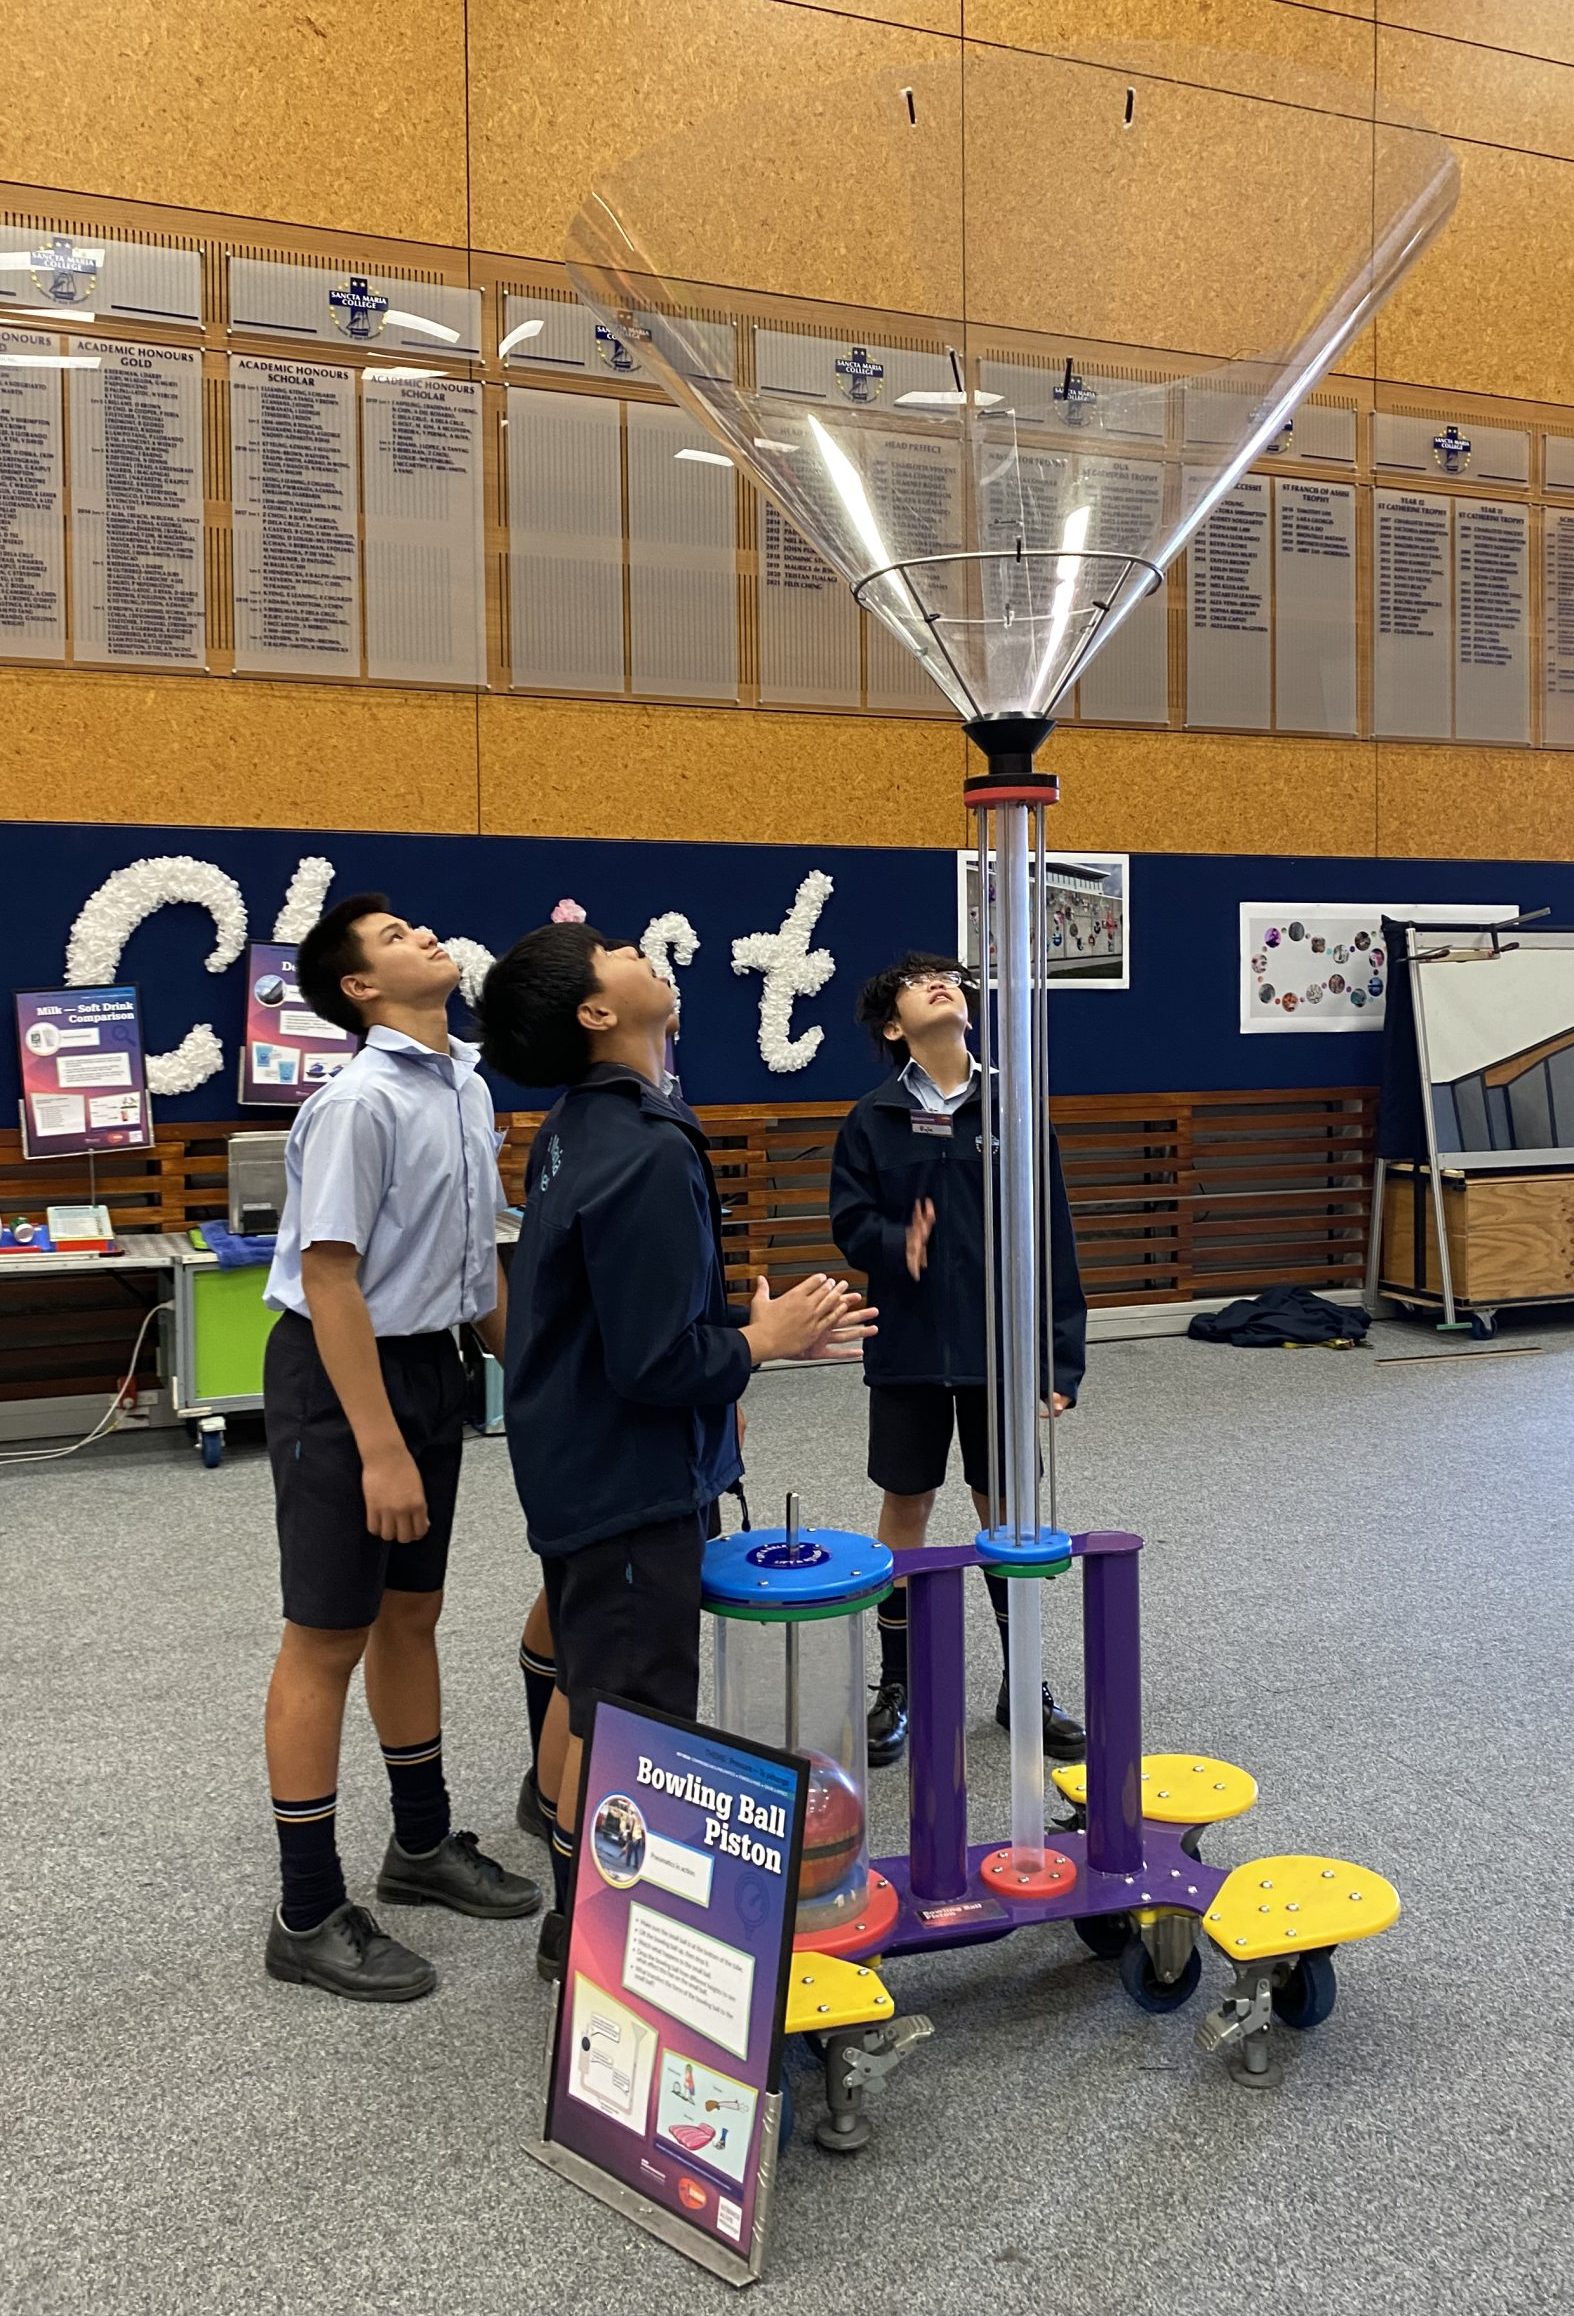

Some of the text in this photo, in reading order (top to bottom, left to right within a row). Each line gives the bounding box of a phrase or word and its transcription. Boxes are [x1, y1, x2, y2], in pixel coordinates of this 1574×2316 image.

[32, 252, 94, 266] SANCTA MARIA
[44, 261, 82, 270] COLLEGE
[331, 292, 387, 304] SANCTA MARIA
[342, 300, 376, 309] COLLEGE
[78, 342, 194, 361] ACADEMIC HONOURS
[121, 358, 152, 368] GOLD
[862, 363, 882, 371] MARIA
[239, 361, 348, 380] ACADEMIC HONOURS
[846, 367, 873, 375] COLLEGE
[268, 374, 314, 386] SCHOLAR
[371, 376, 474, 394] ACADEMIC HONOURS
[401, 390, 445, 401] SCHOLAR
[885, 441, 941, 453] HEAD PREFECT
[1291, 485, 1318, 493] FRANCIS
[1303, 494, 1329, 503] TROPHY
[1401, 497, 1417, 505] YEAR
[1387, 504, 1420, 513] CATHERINE
[1422, 507, 1446, 515] TROPHY
[1466, 513, 1499, 522] CATHERINE
[1501, 517, 1524, 525] TROPHY
[37, 1006, 62, 1016] Milk
[78, 1003, 101, 1013] Soft
[103, 1002, 134, 1011] Drink
[69, 1012, 135, 1023] Comparison
[636, 1756, 733, 1820] Bowling
[738, 1794, 786, 1838] Ball
[704, 1817, 781, 1874] Piston
